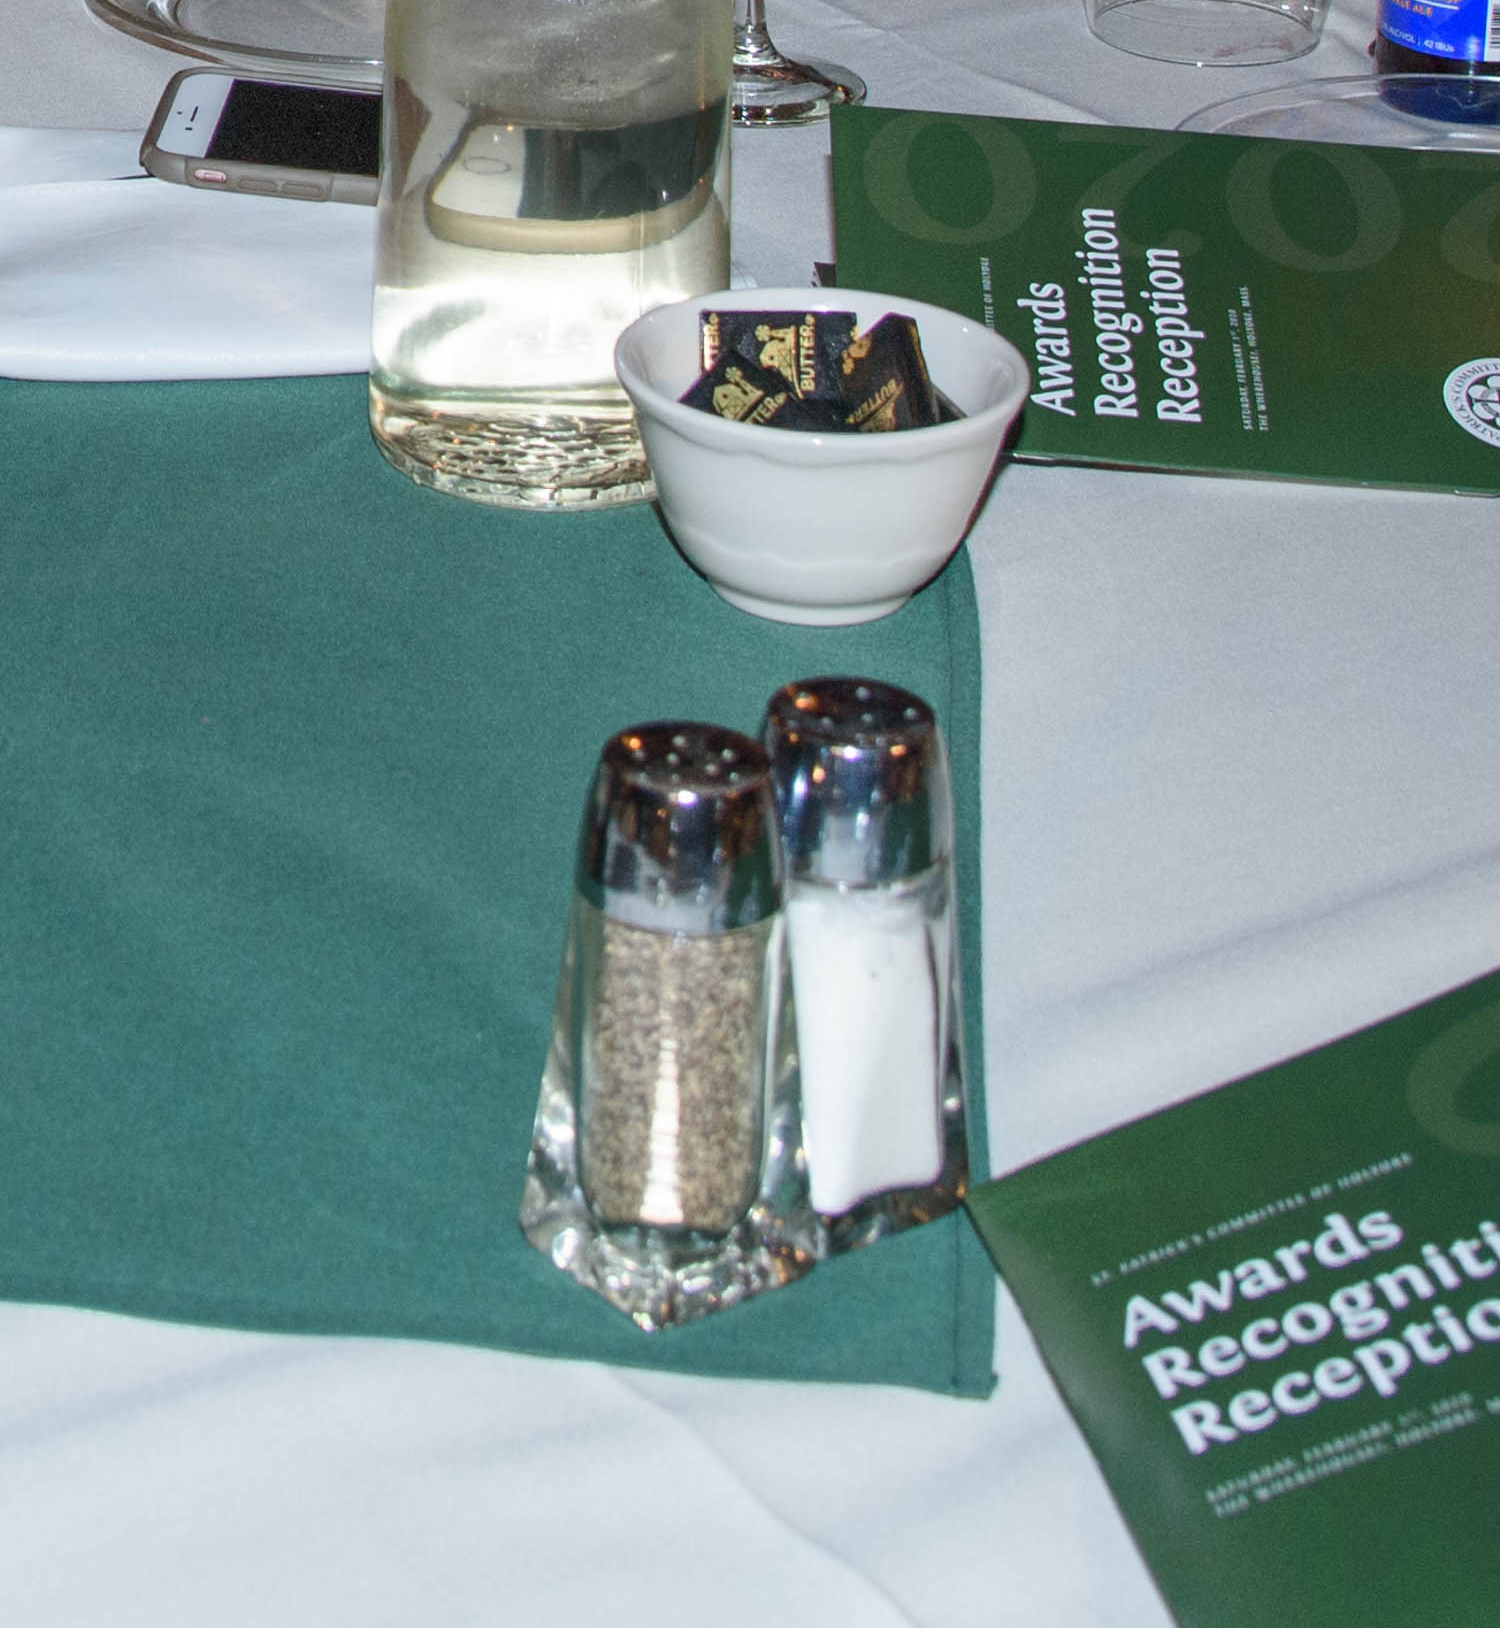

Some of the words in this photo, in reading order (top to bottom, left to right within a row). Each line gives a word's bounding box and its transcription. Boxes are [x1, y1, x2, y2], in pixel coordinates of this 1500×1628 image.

[800, 325, 816, 392] BUTTER
[1016, 282, 1076, 417] Awards
[1075, 207, 1144, 418] Recognition
[1140, 248, 1205, 422] Reception
[1122, 1203, 1404, 1349] Awards
